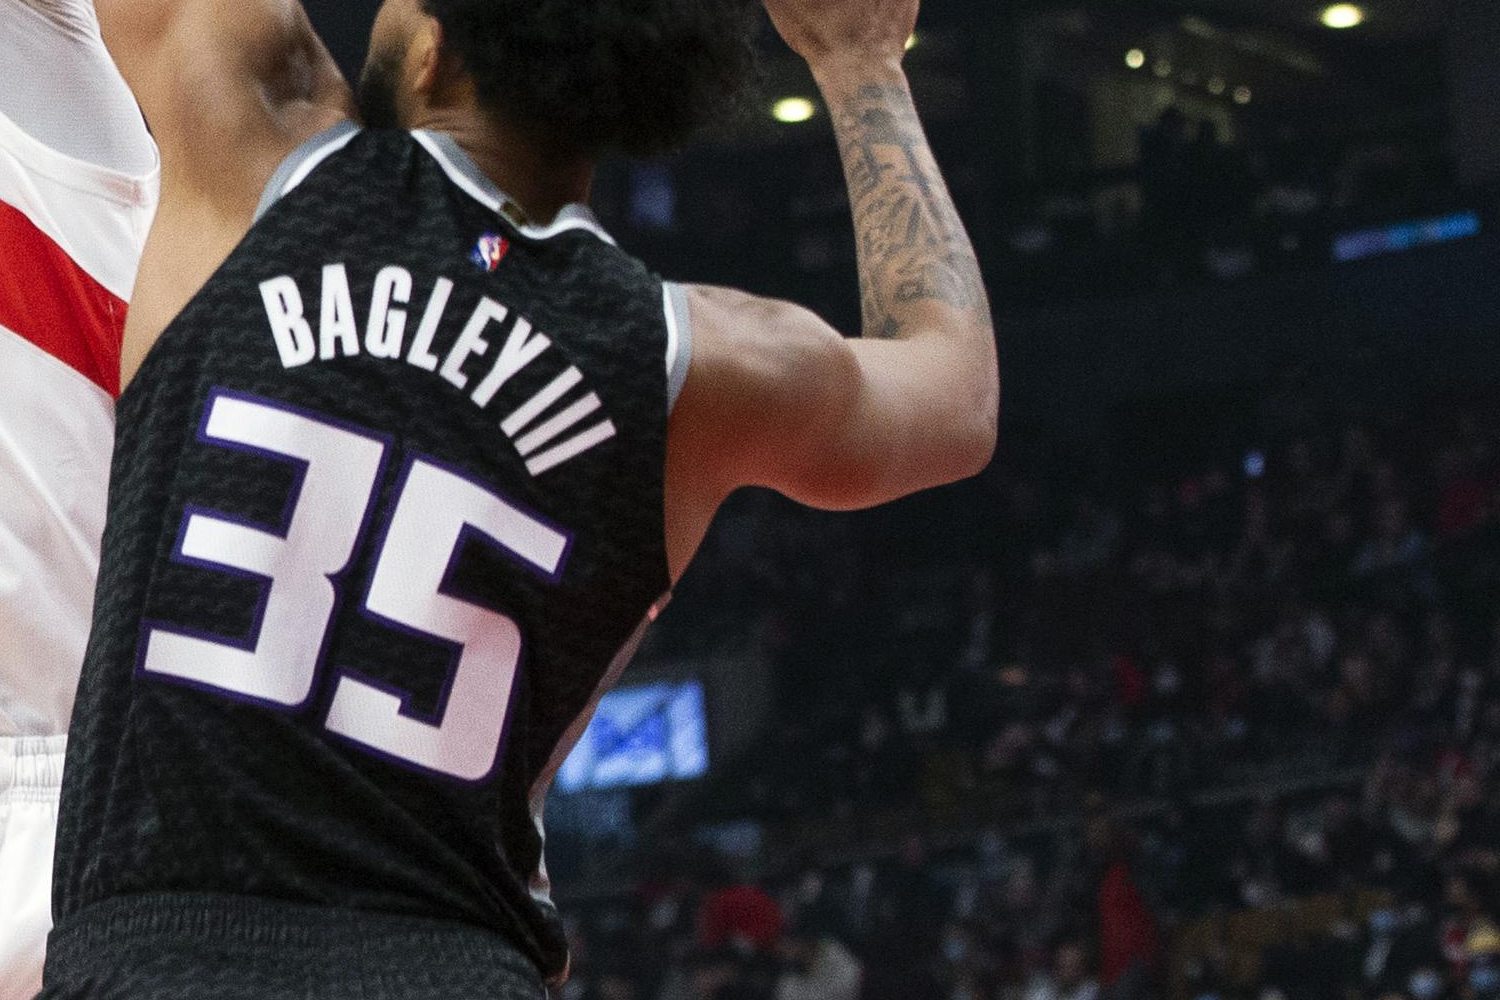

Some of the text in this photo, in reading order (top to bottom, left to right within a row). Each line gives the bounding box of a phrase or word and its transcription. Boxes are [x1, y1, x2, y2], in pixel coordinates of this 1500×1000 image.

[258, 262, 618, 478] BAGLEY III
[137, 386, 575, 785] 35
